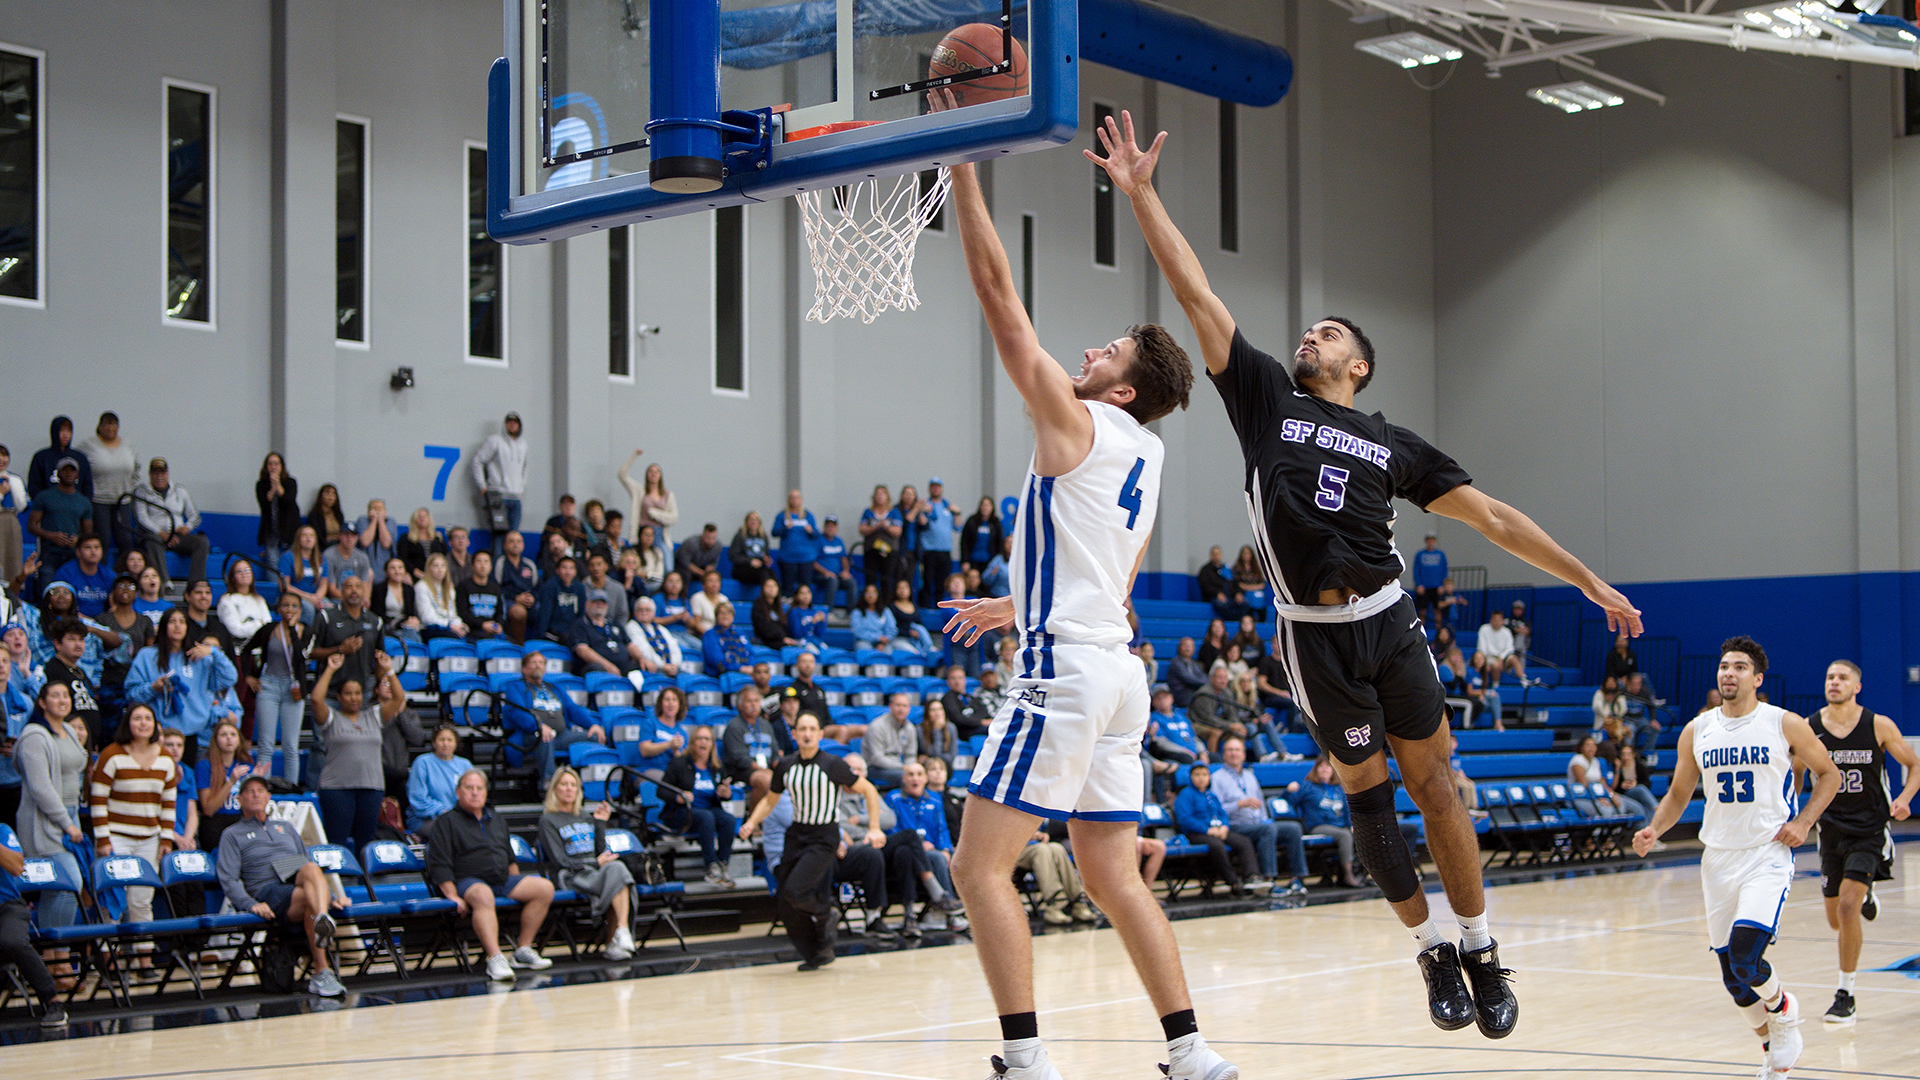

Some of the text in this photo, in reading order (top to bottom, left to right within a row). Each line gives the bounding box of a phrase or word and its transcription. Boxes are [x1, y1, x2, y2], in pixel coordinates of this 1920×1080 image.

[1280, 418, 1392, 471] SF STATE
[423, 445, 460, 501] 7
[1117, 456, 1146, 531] 4
[1314, 463, 1351, 512] 5
[1344, 723, 1371, 747] SF
[1702, 746, 1770, 769] COUGARS
[1833, 749, 1873, 765] STATE
[1716, 770, 1755, 803] 33
